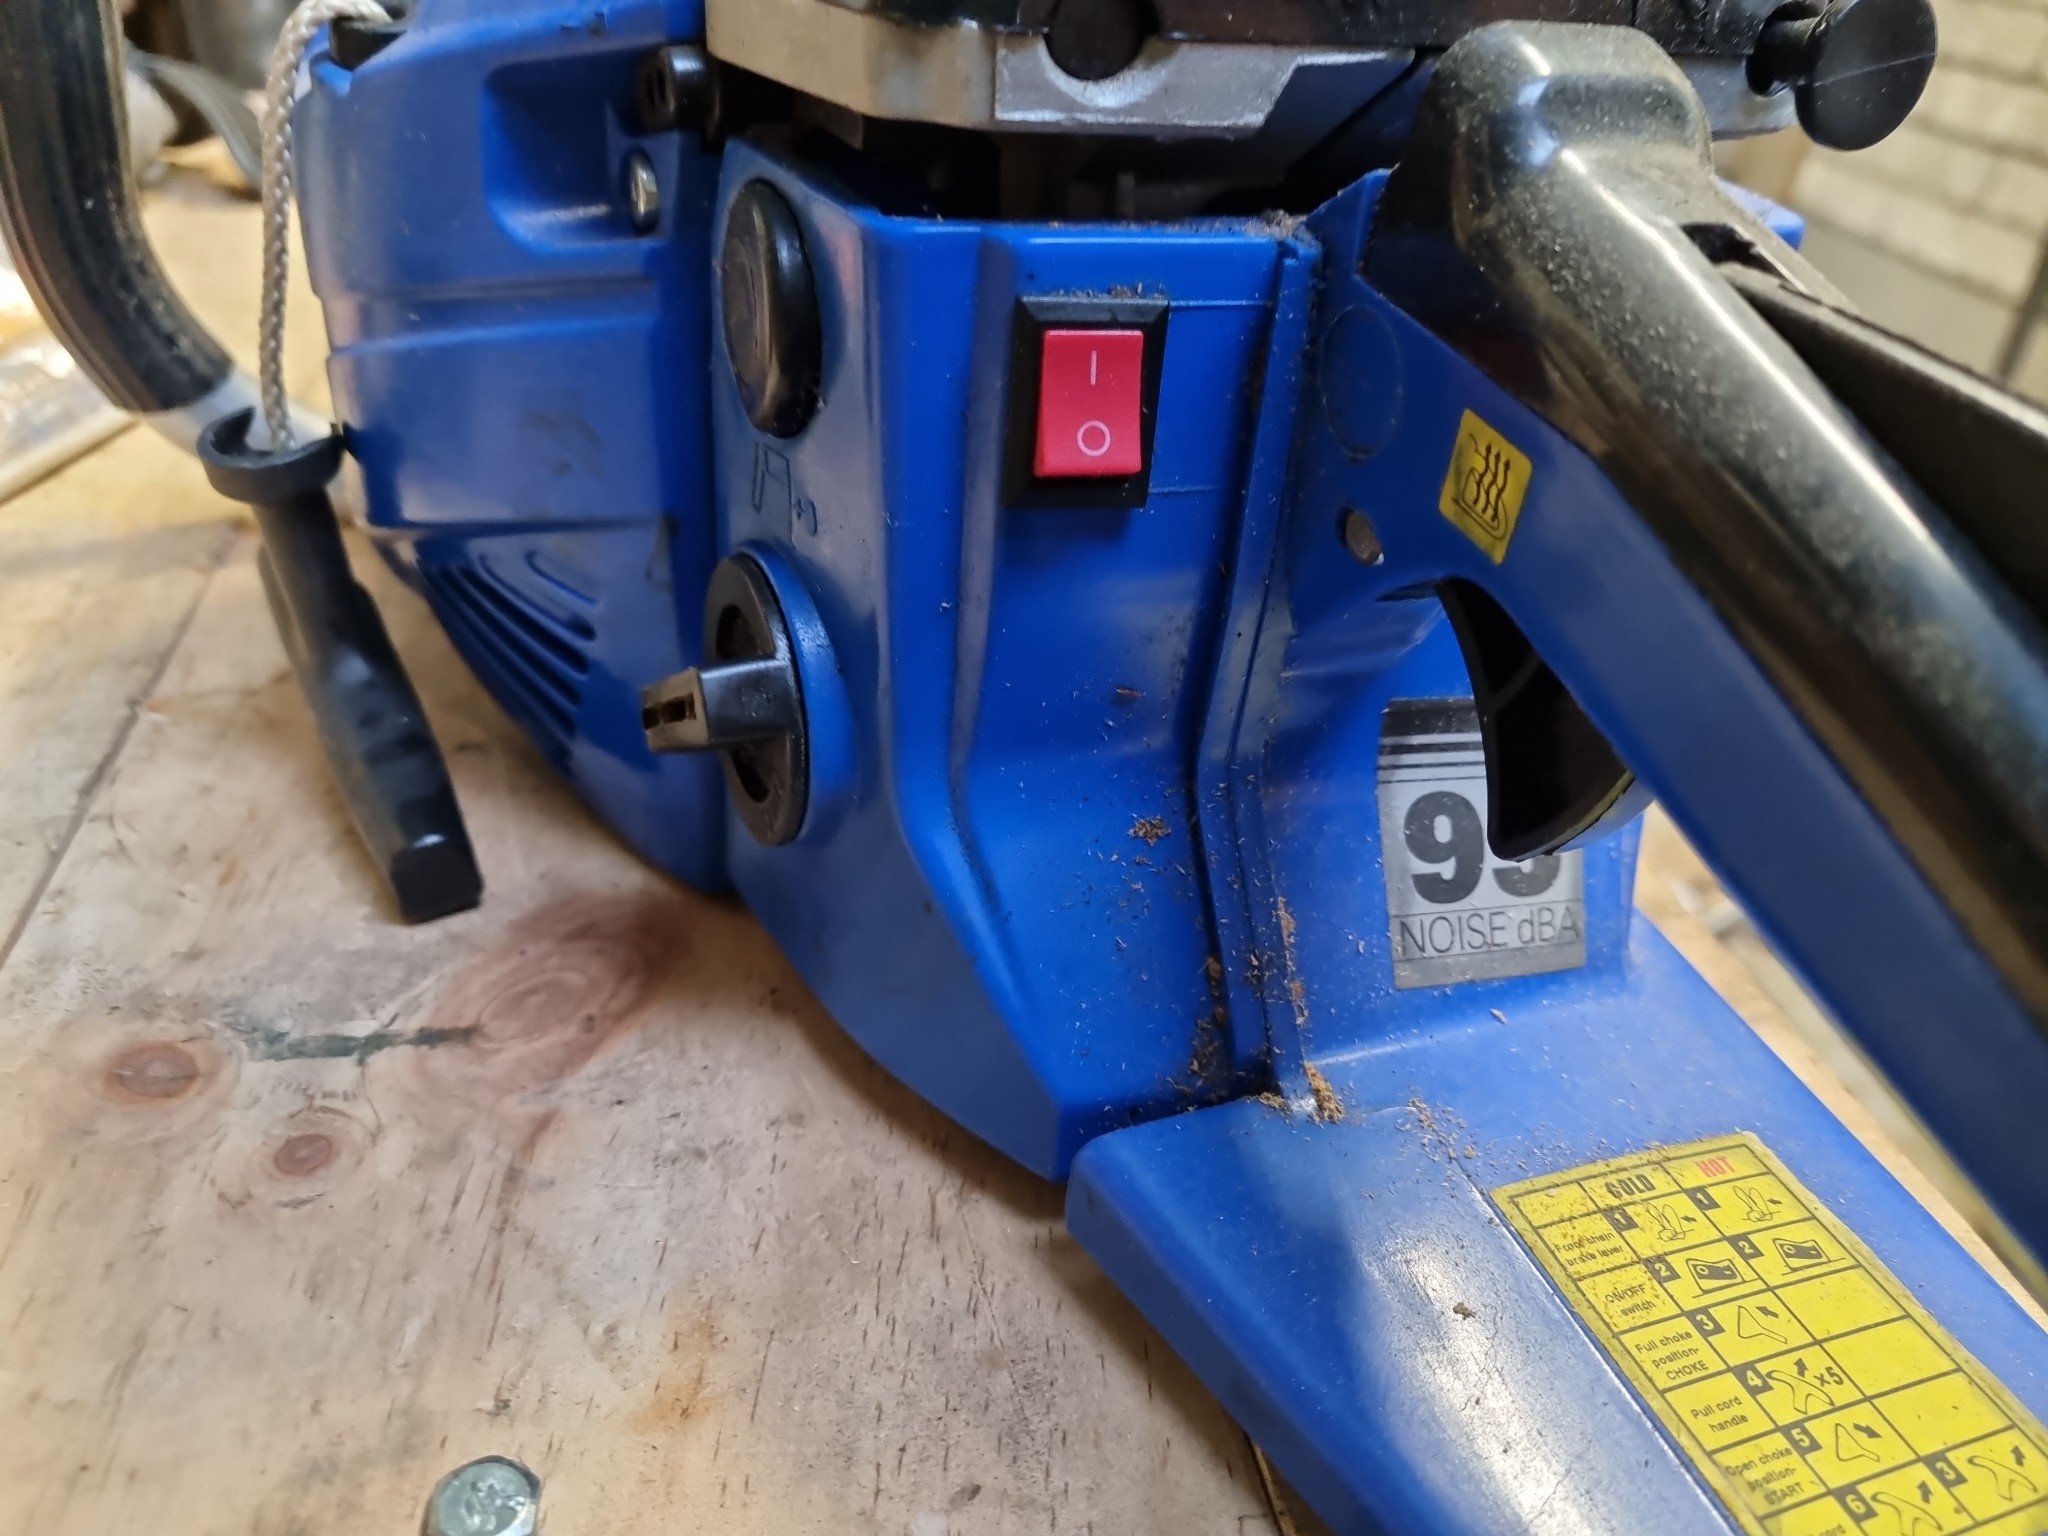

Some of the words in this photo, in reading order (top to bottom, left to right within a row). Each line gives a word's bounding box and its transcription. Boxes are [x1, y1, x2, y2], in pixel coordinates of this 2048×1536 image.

[1400, 910, 1507, 957] NOISE
[1517, 906, 1580, 945] dBA
[1604, 1173, 1656, 1199] COLD
[1695, 1155, 1736, 1178] HOT
[1587, 1231, 1616, 1245] chain
[1565, 1252, 1598, 1267] brake
[1597, 1245, 1624, 1258] lever
[1604, 1284, 1647, 1304] ON/OFF
[1619, 1300, 1657, 1317] switch
[1696, 1314, 1714, 1331] 3
[1634, 1339, 1659, 1354] Full
[1660, 1329, 1694, 1346] choke
[1666, 1360, 1709, 1381] CHOKE
[1746, 1369, 1764, 1389] 4
[1690, 1404, 1714, 1420] Pull
[1716, 1395, 1742, 1410] cord
[1709, 1413, 1749, 1433] handle
[1791, 1428, 1811, 1448] 5
[1725, 1459, 1758, 1478] Open
[1758, 1447, 1793, 1464] choke
[1763, 1482, 1805, 1505] START
[1845, 1494, 1866, 1514] 6
